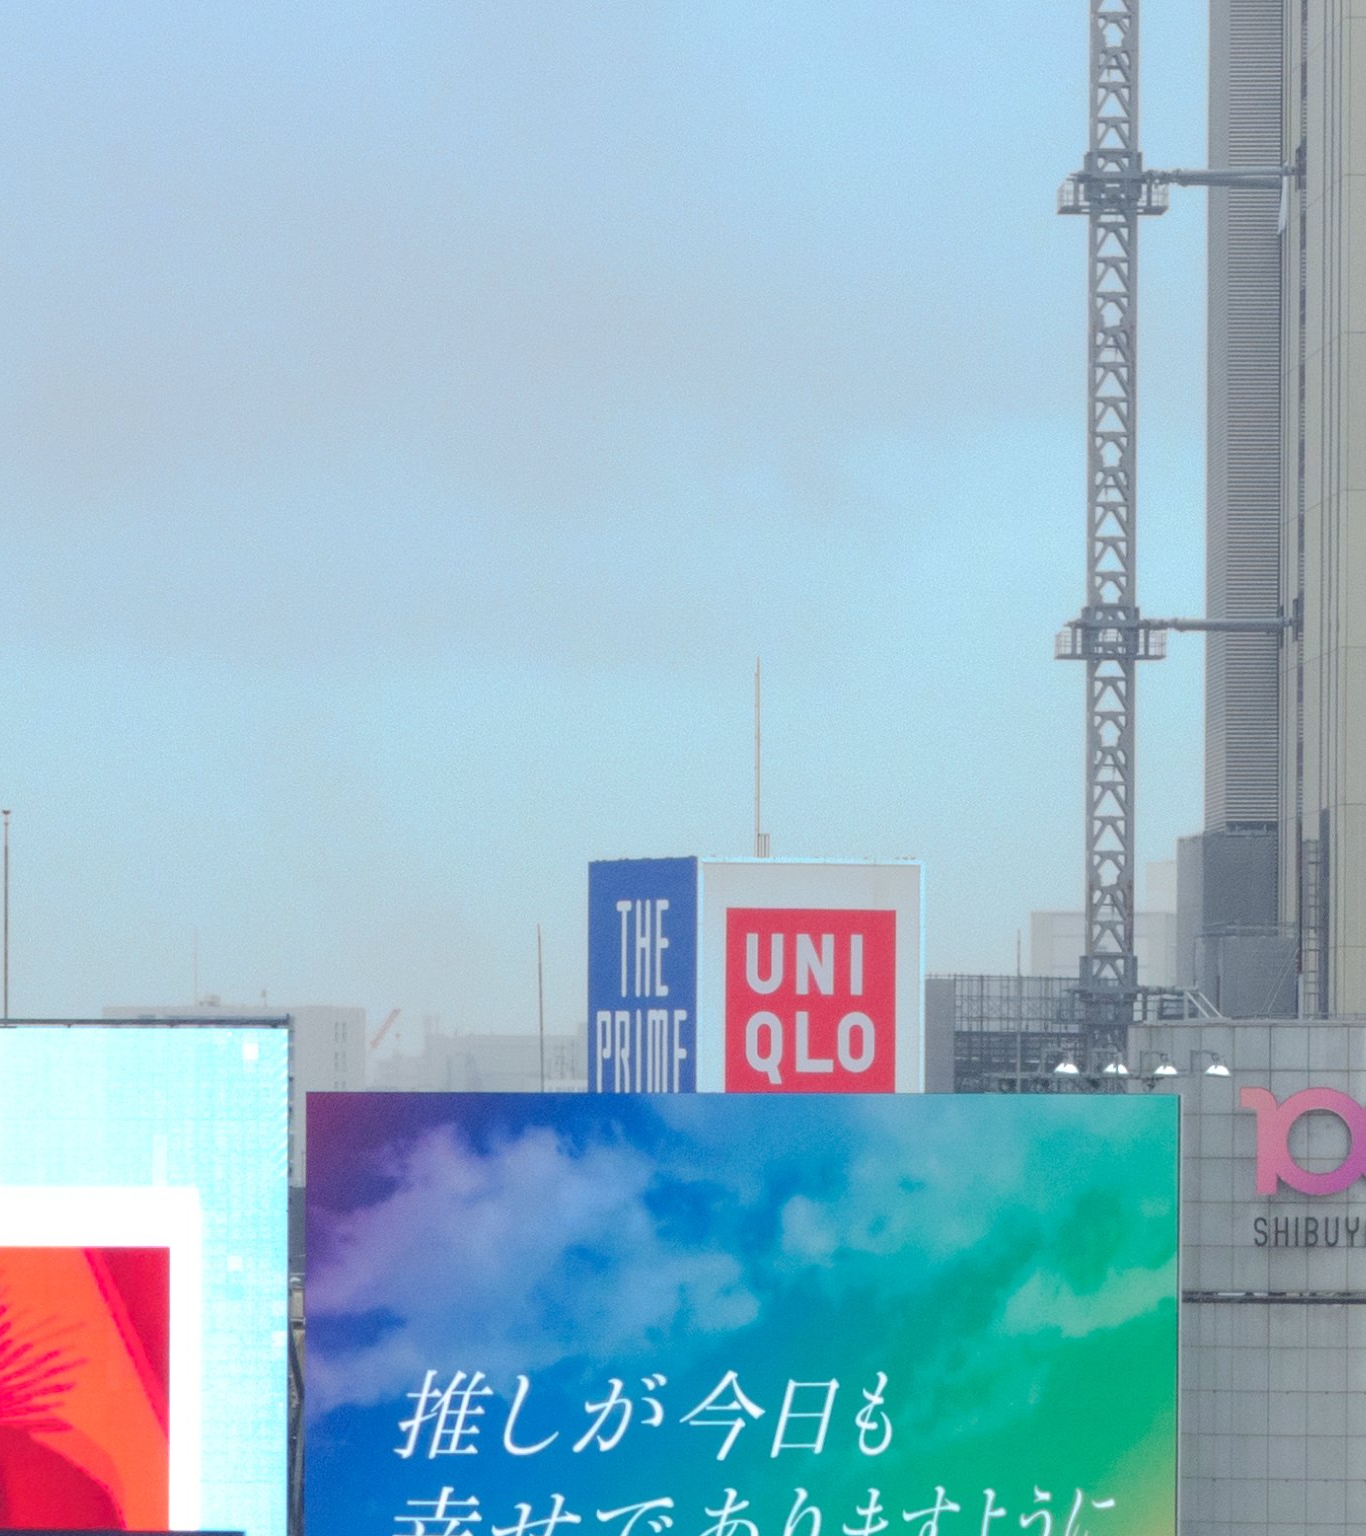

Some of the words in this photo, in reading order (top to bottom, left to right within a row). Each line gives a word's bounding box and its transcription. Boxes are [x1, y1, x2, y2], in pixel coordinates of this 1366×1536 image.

[616, 899, 670, 998] THE
[746, 932, 864, 996] UNI
[596, 1009, 688, 1094] PRIME
[745, 1010, 876, 1085] QLO
[391, 1369, 895, 1461] 推しが今日も
